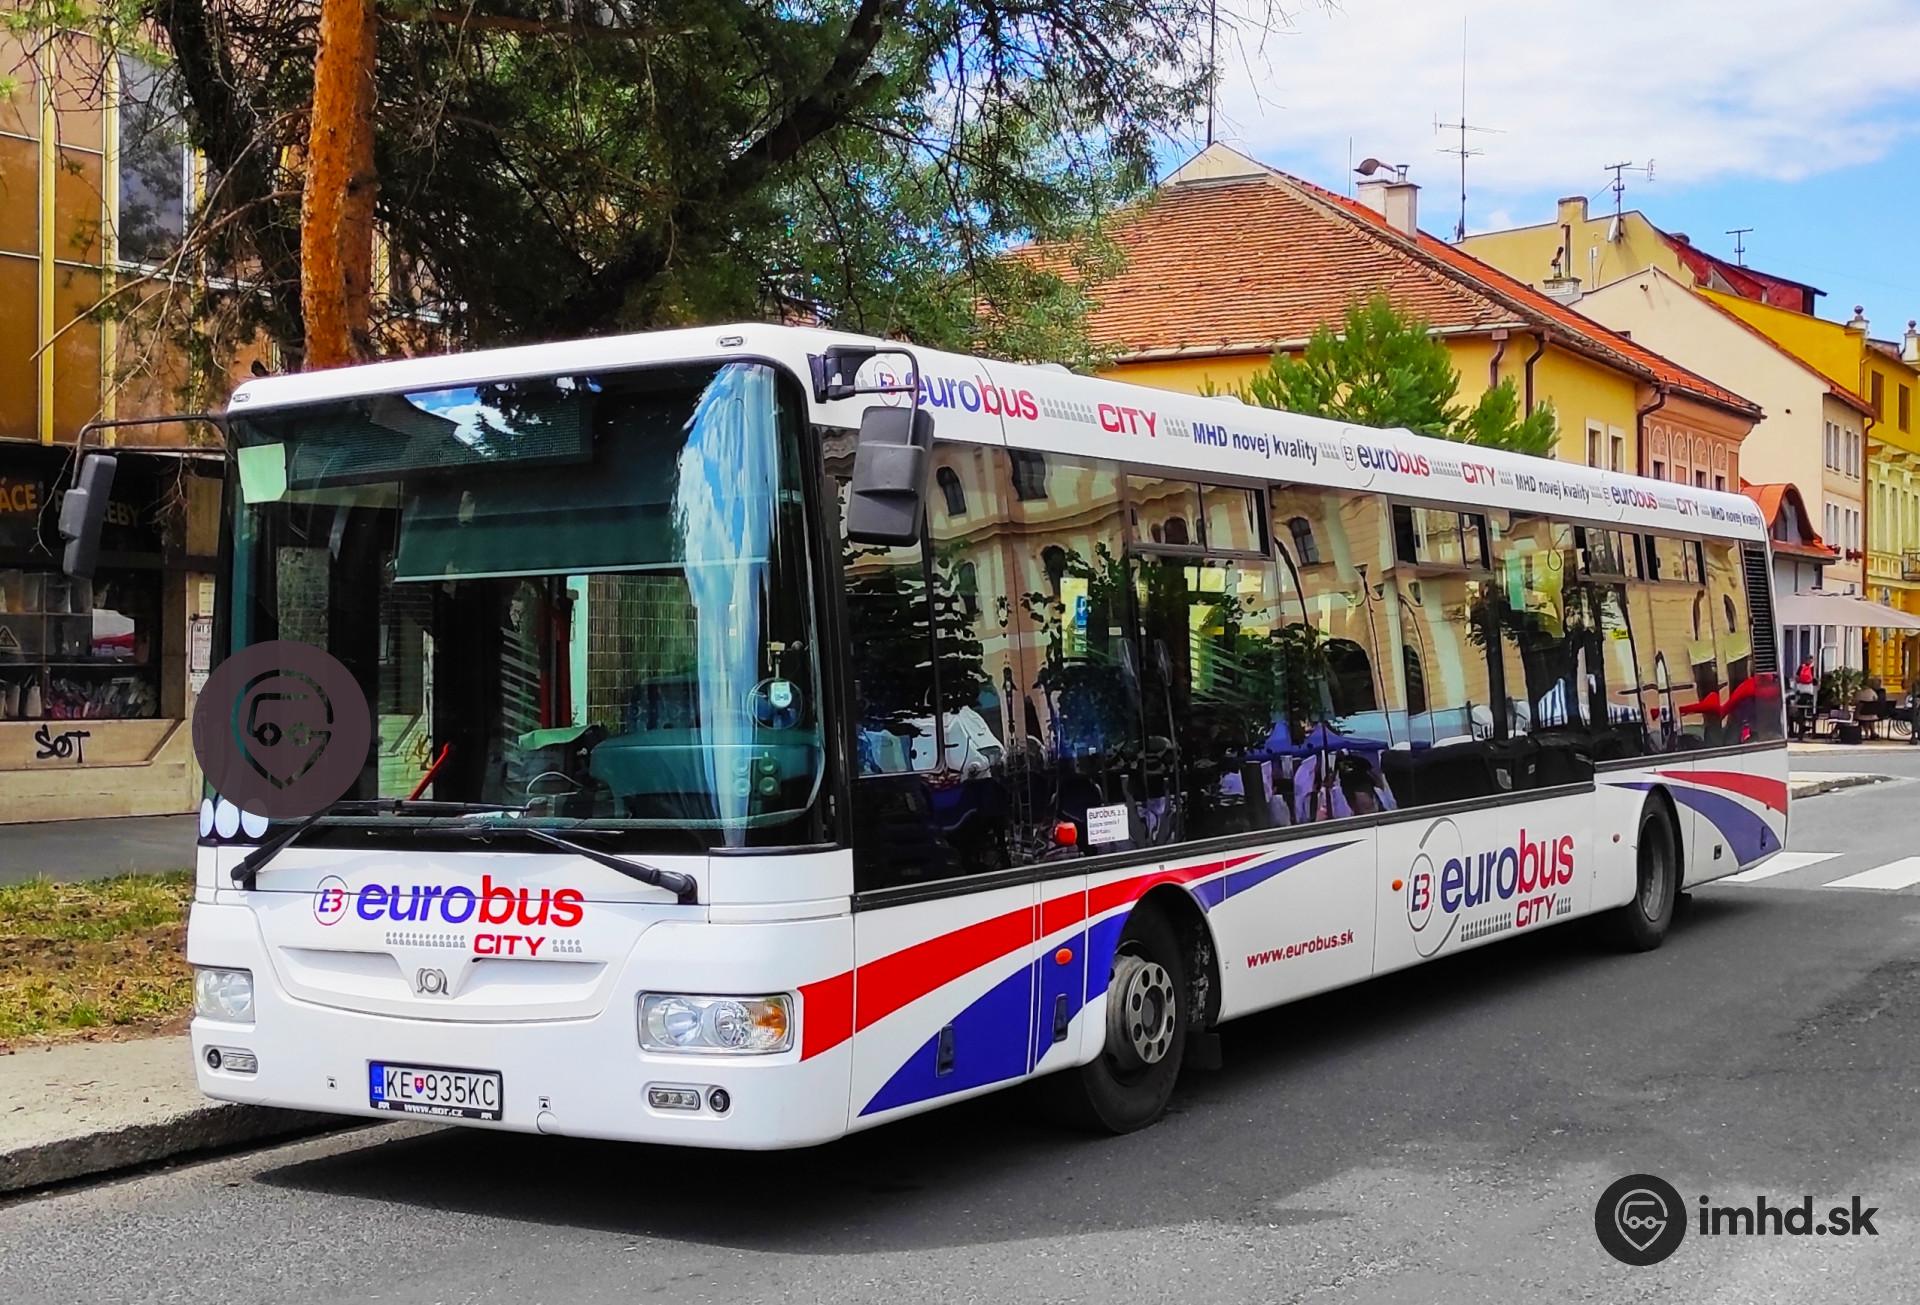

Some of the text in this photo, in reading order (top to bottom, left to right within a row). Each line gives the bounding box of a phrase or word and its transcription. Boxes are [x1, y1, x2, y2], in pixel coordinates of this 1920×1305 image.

[905, 372, 1038, 421] eurobus
[1098, 403, 1156, 437] CITY
[1193, 422, 1227, 447] MHD
[1232, 433, 1269, 459] novej
[1272, 434, 1317, 466] kvality
[1357, 444, 1430, 477] eurobus
[1461, 462, 1495, 486] CITY
[1515, 473, 1536, 492] MHD
[1539, 480, 1562, 500] novej
[1611, 485, 1658, 510] eurobus
[1440, 829, 1574, 913] eurobus
[356, 875, 584, 927] eurobus
[1516, 893, 1557, 928] CITY
[474, 934, 546, 956] CITY
[1246, 929, 1354, 969] www.eurobus.sk
[404, 1104, 463, 1117] www.sor.cz
